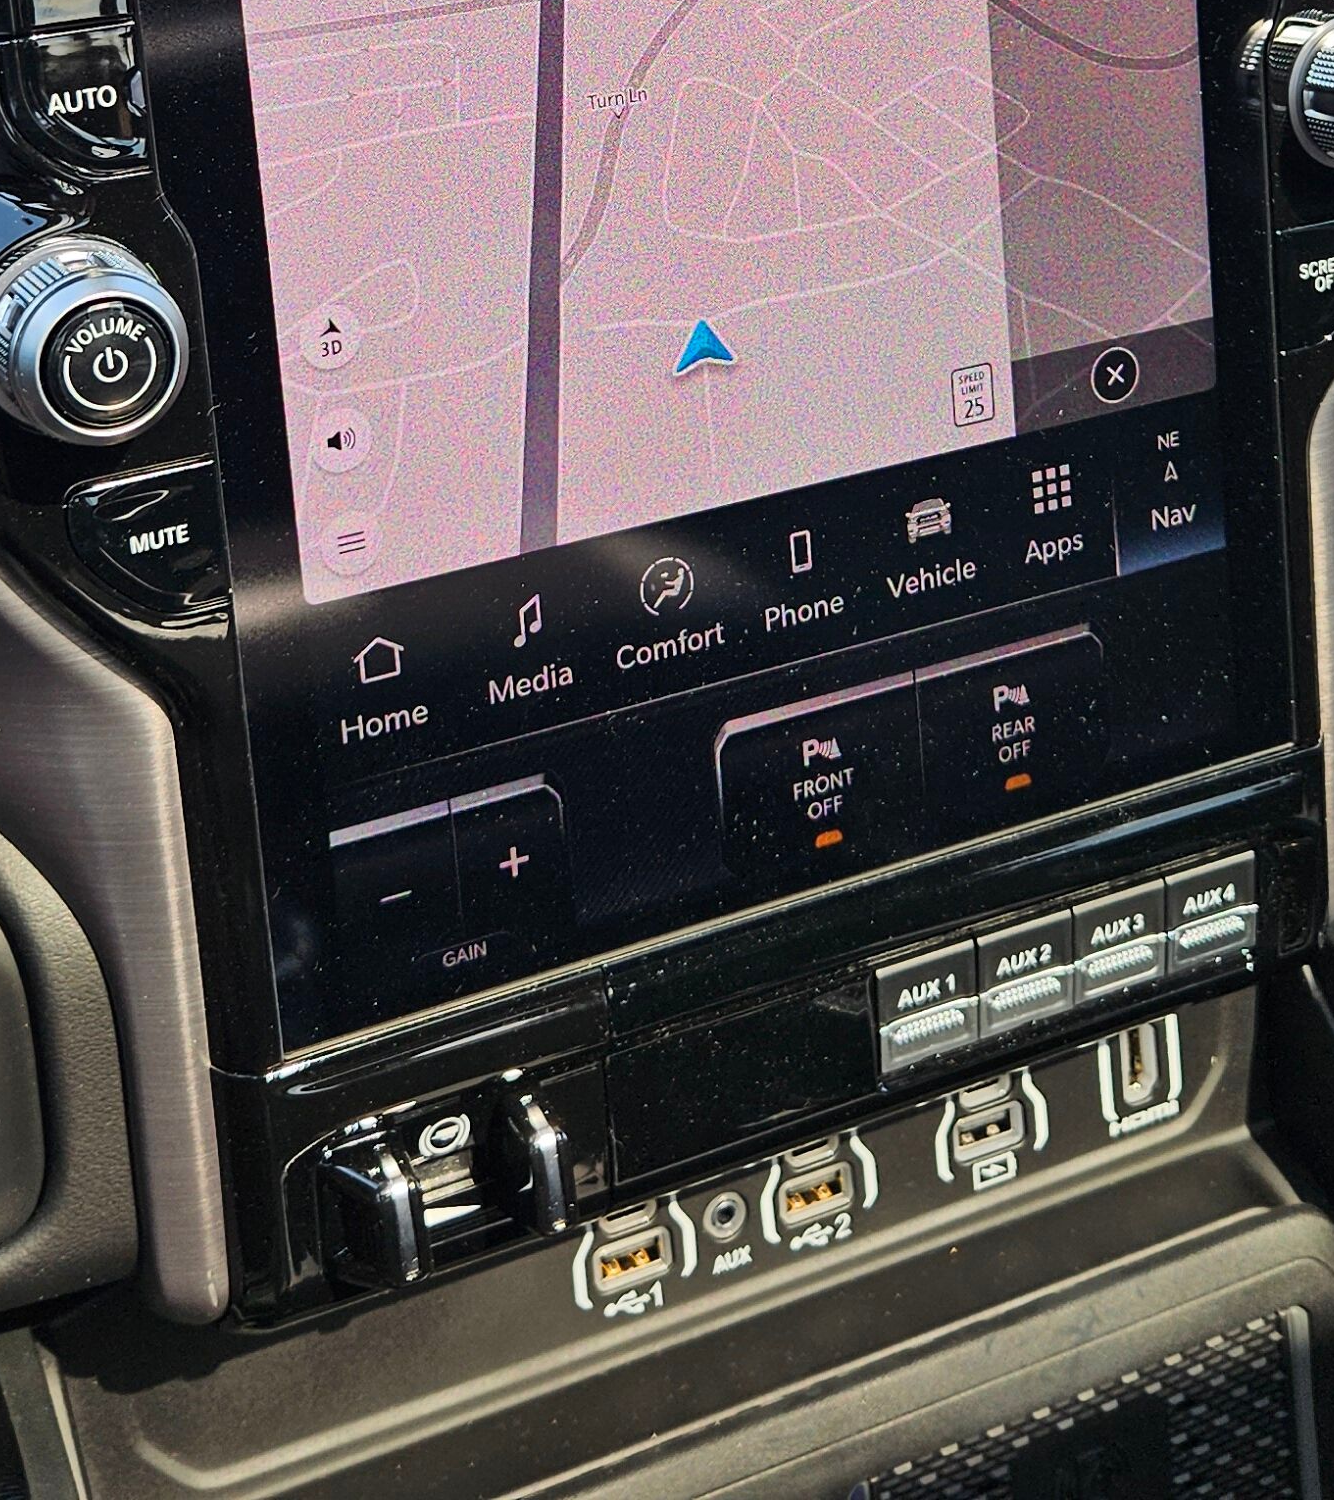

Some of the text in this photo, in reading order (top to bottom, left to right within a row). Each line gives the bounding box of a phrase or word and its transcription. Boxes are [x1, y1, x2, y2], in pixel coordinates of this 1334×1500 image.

[47, 83, 118, 116] AUTO
[588, 88, 648, 110] Turn Ln
[65, 316, 147, 355] VOLUME
[320, 338, 343, 358] 3D
[958, 370, 985, 385] SPEED
[960, 383, 984, 397] LIMIT
[964, 399, 985, 419] 25
[1157, 431, 1180, 451] NE
[1151, 502, 1197, 531] Nav
[129, 523, 191, 555] MUTE
[1024, 531, 1084, 567] Apps
[886, 558, 977, 599] Vehicle
[764, 594, 845, 633] Phone
[616, 622, 725, 671] Comfort
[488, 663, 574, 704] Media
[340, 703, 429, 745] Home
[991, 715, 1036, 743] REAR
[998, 739, 1032, 764] OFF
[793, 767, 855, 801] FRONT
[807, 794, 843, 820] OFF
[1183, 882, 1236, 915] AUX 4
[1091, 913, 1145, 946] AUX 3
[442, 940, 487, 968] GAIN
[996, 943, 1053, 979] AUX 2
[897, 973, 956, 1010] AUX 1
[834, 1214, 852, 1241] 2
[712, 1244, 752, 1276] AUX
[649, 1281, 664, 1308] 1
